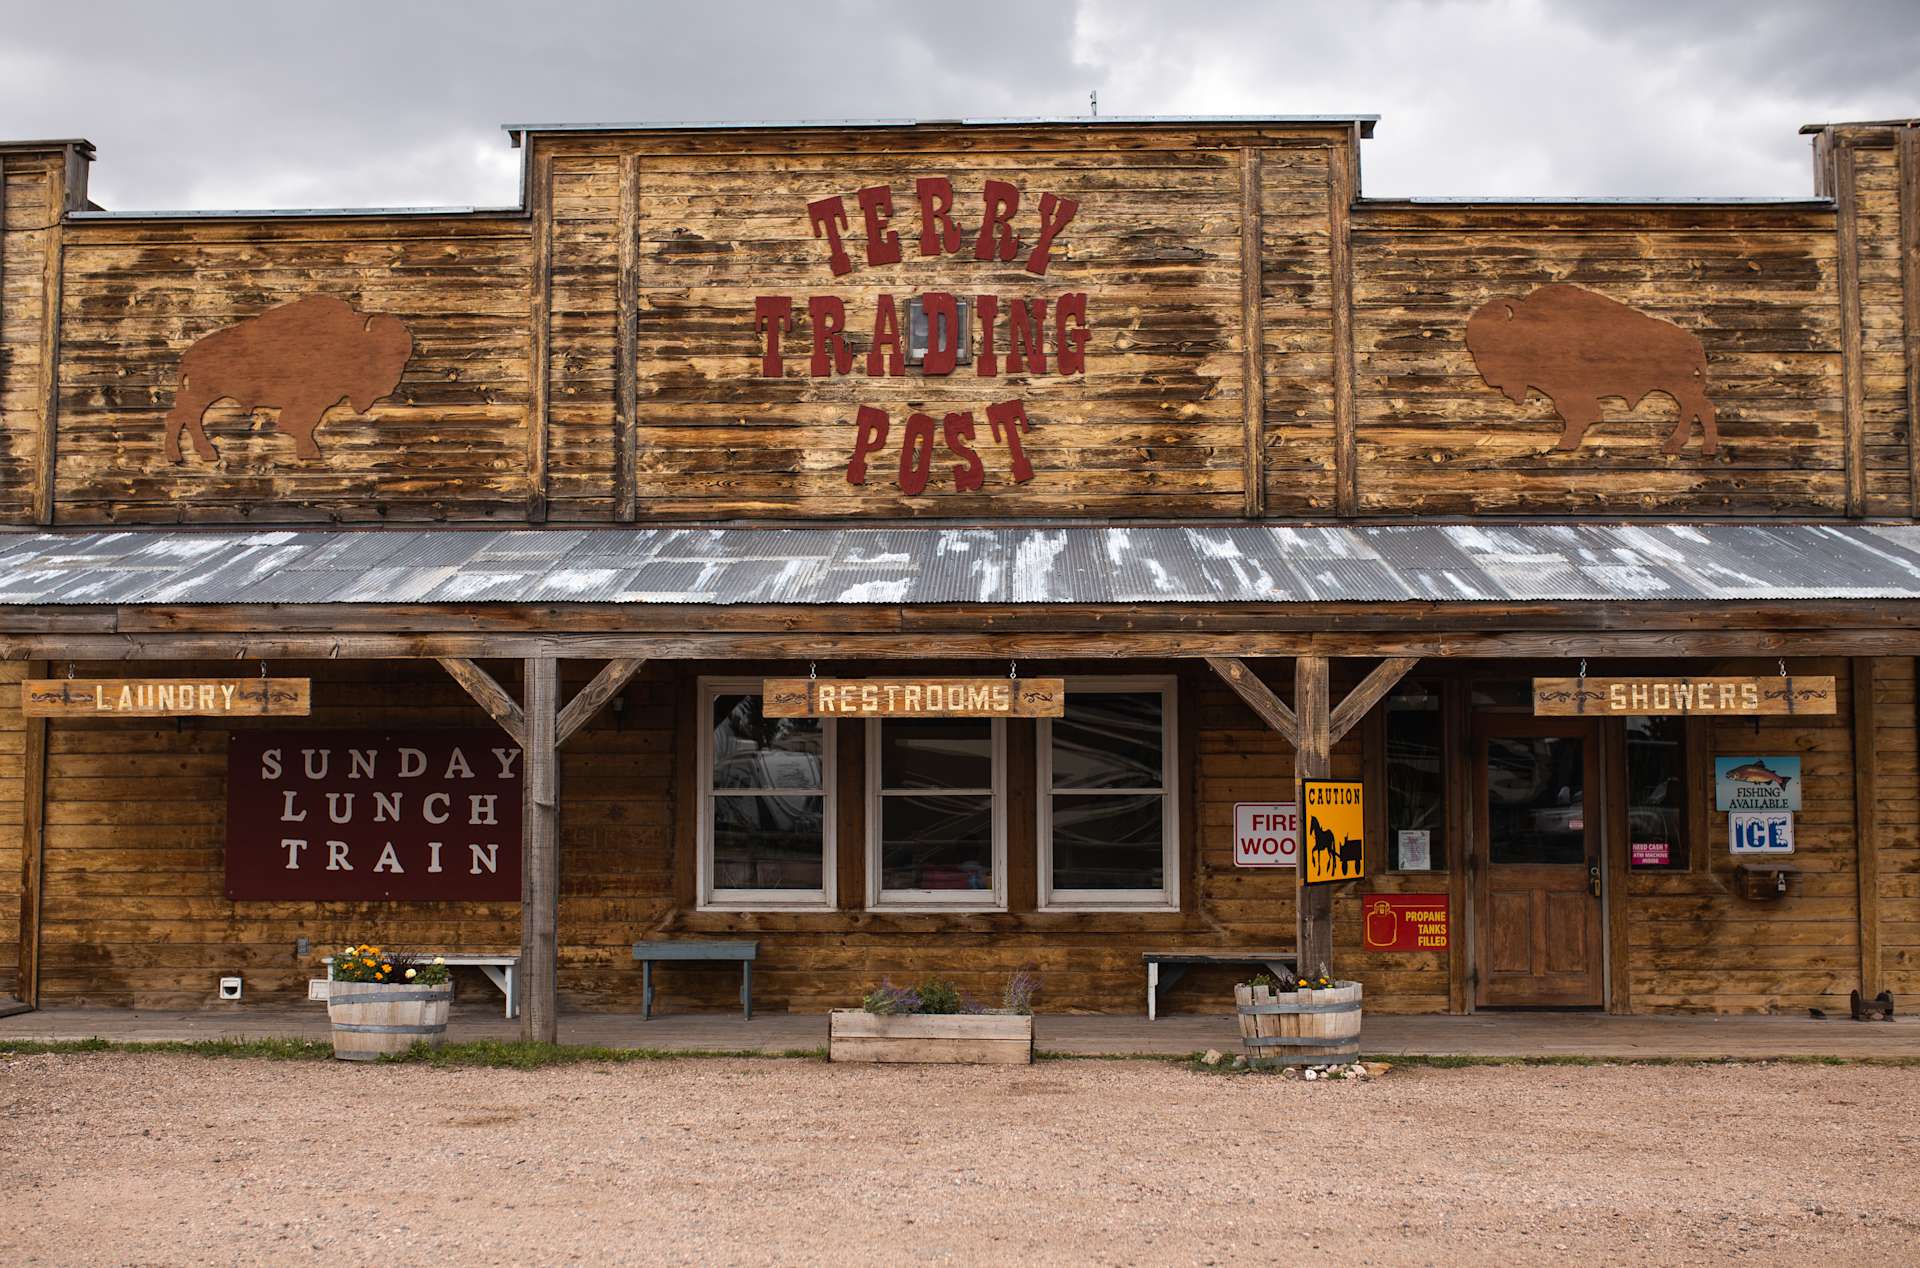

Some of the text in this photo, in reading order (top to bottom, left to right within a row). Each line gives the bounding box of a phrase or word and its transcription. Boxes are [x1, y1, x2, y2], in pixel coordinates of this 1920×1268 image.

[807, 177, 1079, 277] TERRY
[755, 292, 1092, 377] TRADING
[846, 400, 1035, 496] POST
[96, 685, 236, 711] LAUNDRY
[818, 685, 1010, 712] RESTROOMS
[1610, 683, 1758, 709] SHOWERS
[261, 747, 521, 780] SUNDAY
[1308, 788, 1360, 805] CAUTION
[1729, 799, 1789, 809] AVAILABLE
[1737, 787, 1780, 798] FISHING
[280, 790, 498, 825] LUNCH
[1252, 814, 1296, 831] FIRE
[1735, 816, 1788, 848] ICE
[281, 839, 499, 874] TRAIN
[1240, 837, 1296, 855] WOO
[1405, 911, 1446, 922] PROPANE
[1418, 924, 1447, 934] TANKS
[1418, 936, 1447, 947] FILLED
